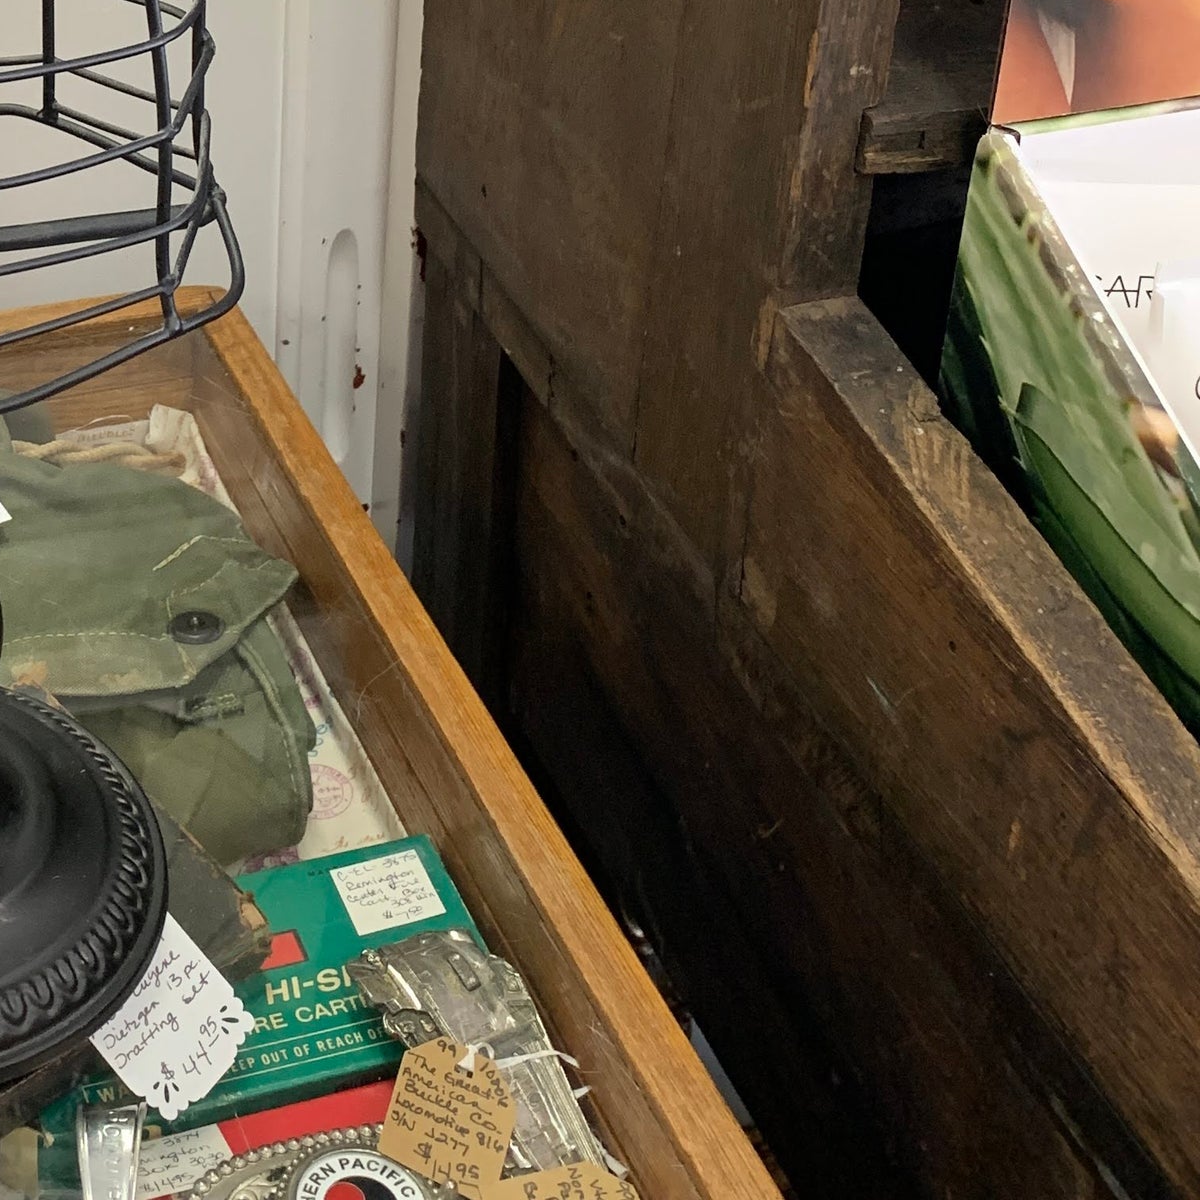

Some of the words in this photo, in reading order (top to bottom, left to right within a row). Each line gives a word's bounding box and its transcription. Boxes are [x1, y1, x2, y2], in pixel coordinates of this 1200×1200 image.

[346, 870, 415, 891] Remington
[113, 1012, 180, 1070] Drafting
[260, 1049, 289, 1066] OUT
[293, 1043, 312, 1058] OF
[316, 1030, 365, 1052] REACH
[436, 1038, 458, 1058] 99
[407, 1051, 437, 1077] The
[402, 1066, 493, 1116] American
[404, 1078, 460, 1116] Buckle
[394, 1091, 470, 1137] Locomotive
[337, 1156, 417, 1199] PACIFIC
